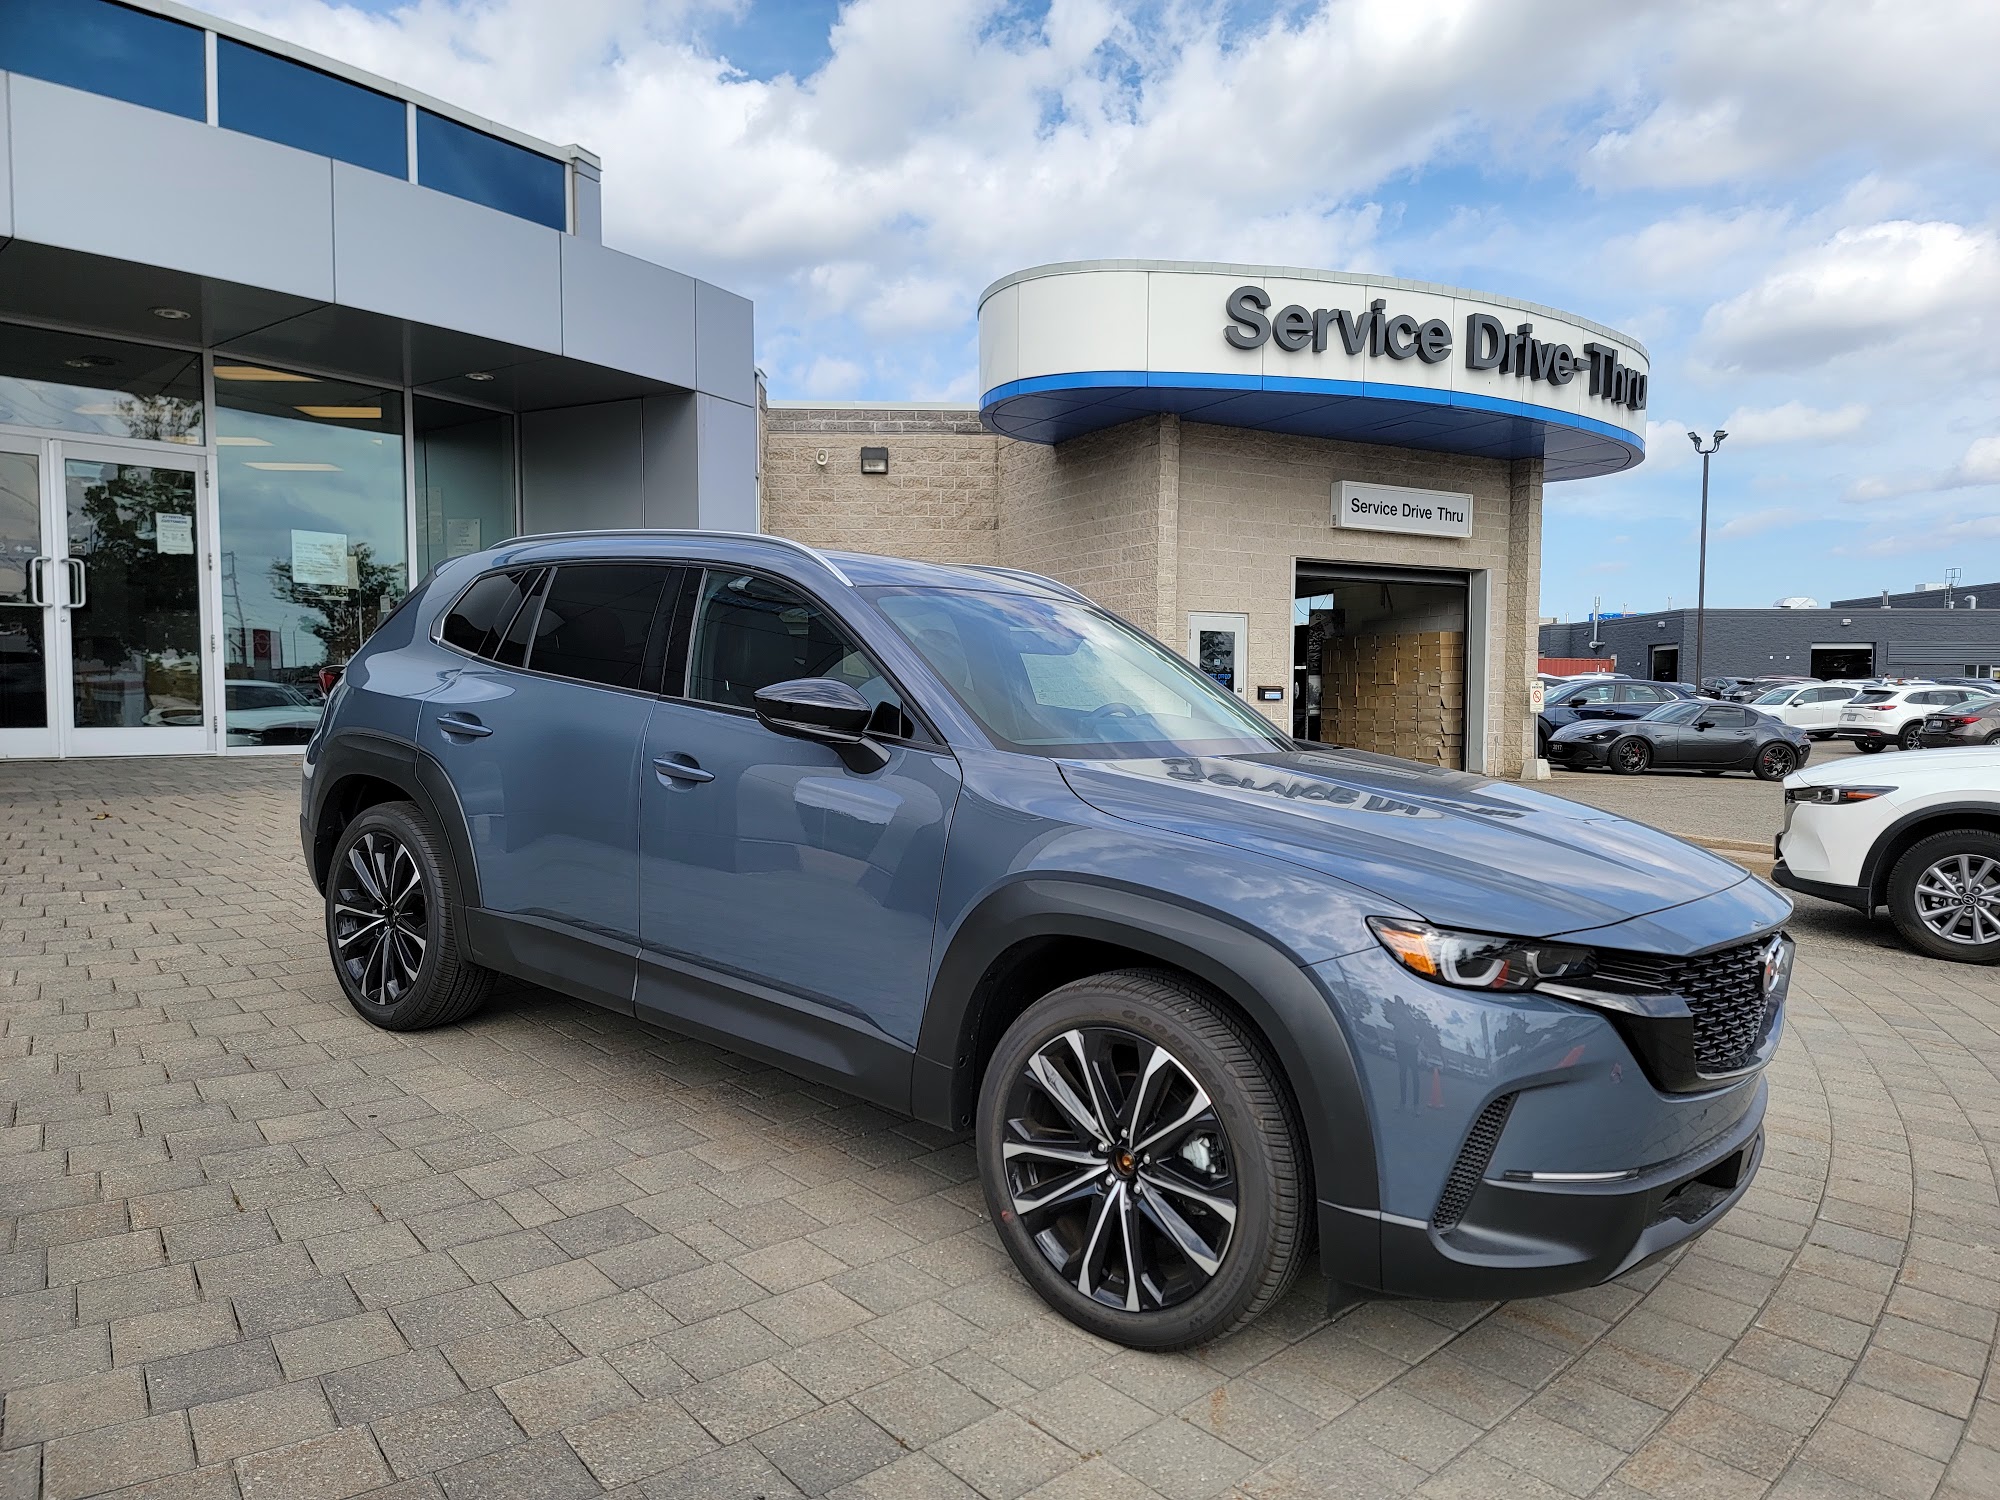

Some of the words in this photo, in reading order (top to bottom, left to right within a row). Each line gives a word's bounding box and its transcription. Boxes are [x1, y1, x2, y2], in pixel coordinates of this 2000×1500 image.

[1223, 285, 1453, 364] Service
[1466, 312, 1648, 411] Drive-Thru
[1351, 497, 1398, 516] Service
[1402, 503, 1432, 520] Drive
[1437, 507, 1464, 523] Thru
